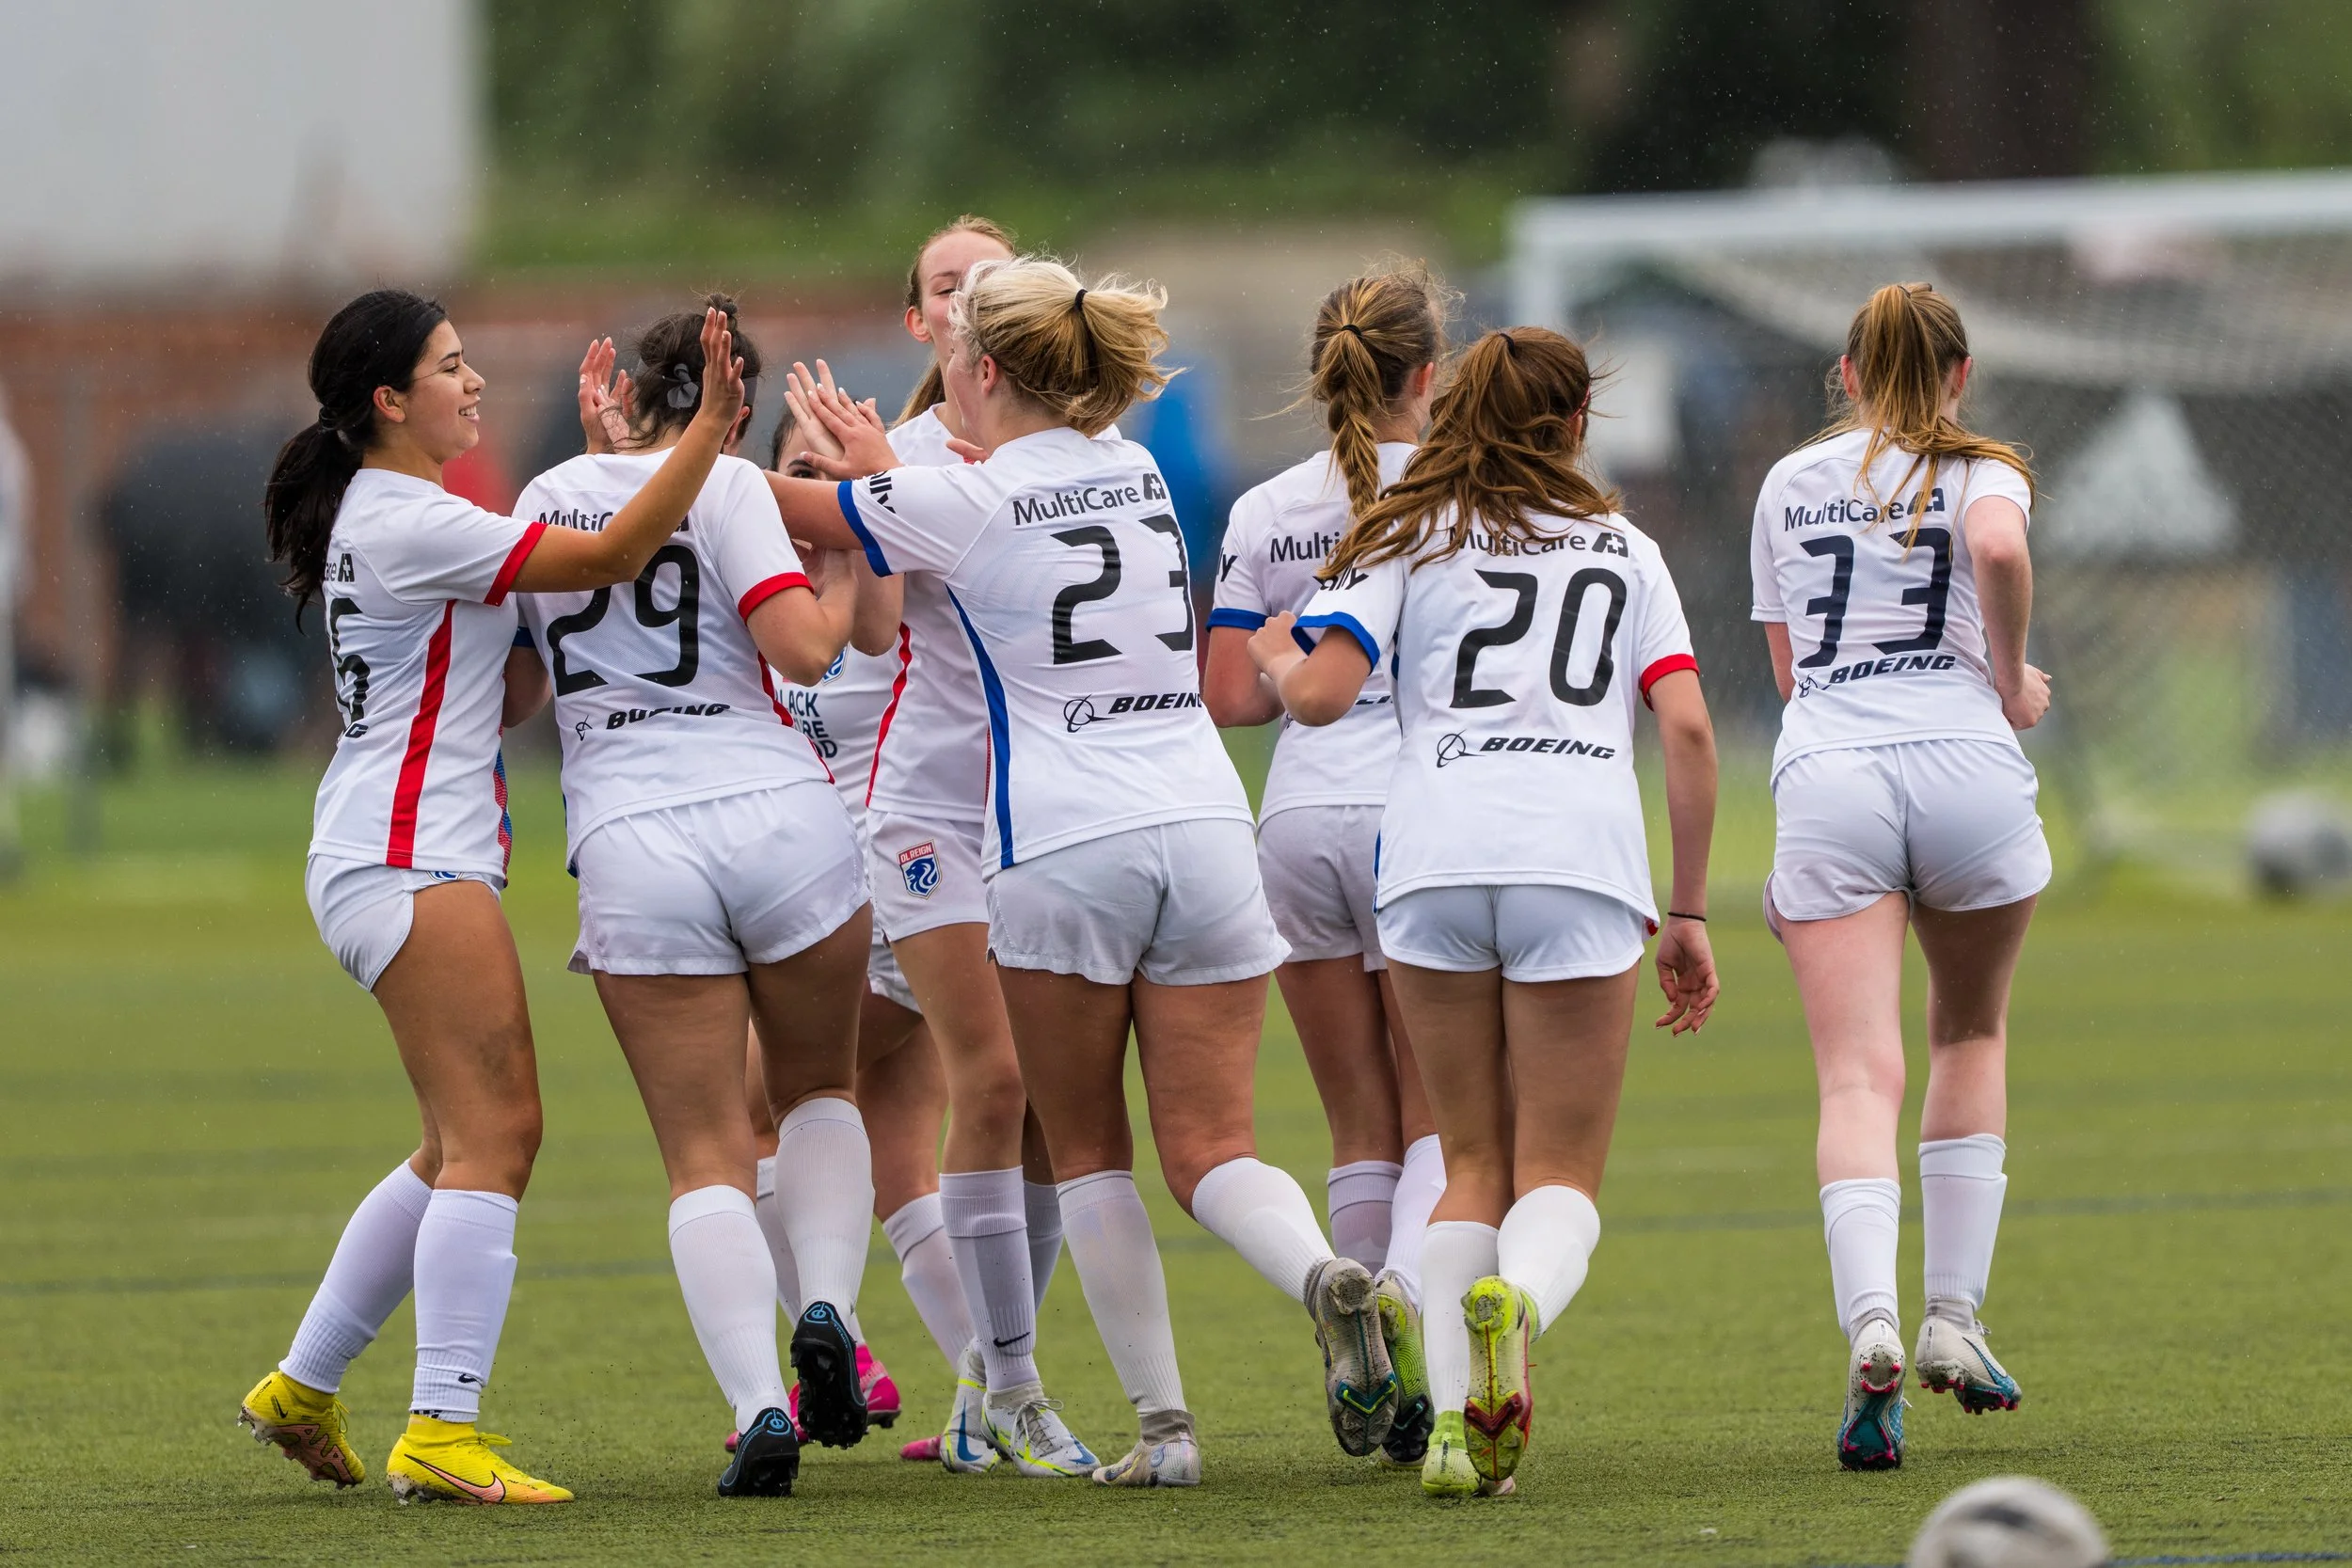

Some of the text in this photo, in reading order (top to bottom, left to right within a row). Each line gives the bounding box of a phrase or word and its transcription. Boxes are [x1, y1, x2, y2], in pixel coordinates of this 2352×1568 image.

[1012, 484, 1141, 526] MultiCare
[546, 544, 700, 697] 29
[1049, 513, 1194, 665] 23
[1797, 527, 1953, 669] 33
[1449, 567, 1628, 708] 20
[1828, 655, 1956, 684] BOEING
[1479, 736, 1616, 760] BOEING
[900, 844, 932, 863] OL REIGN
